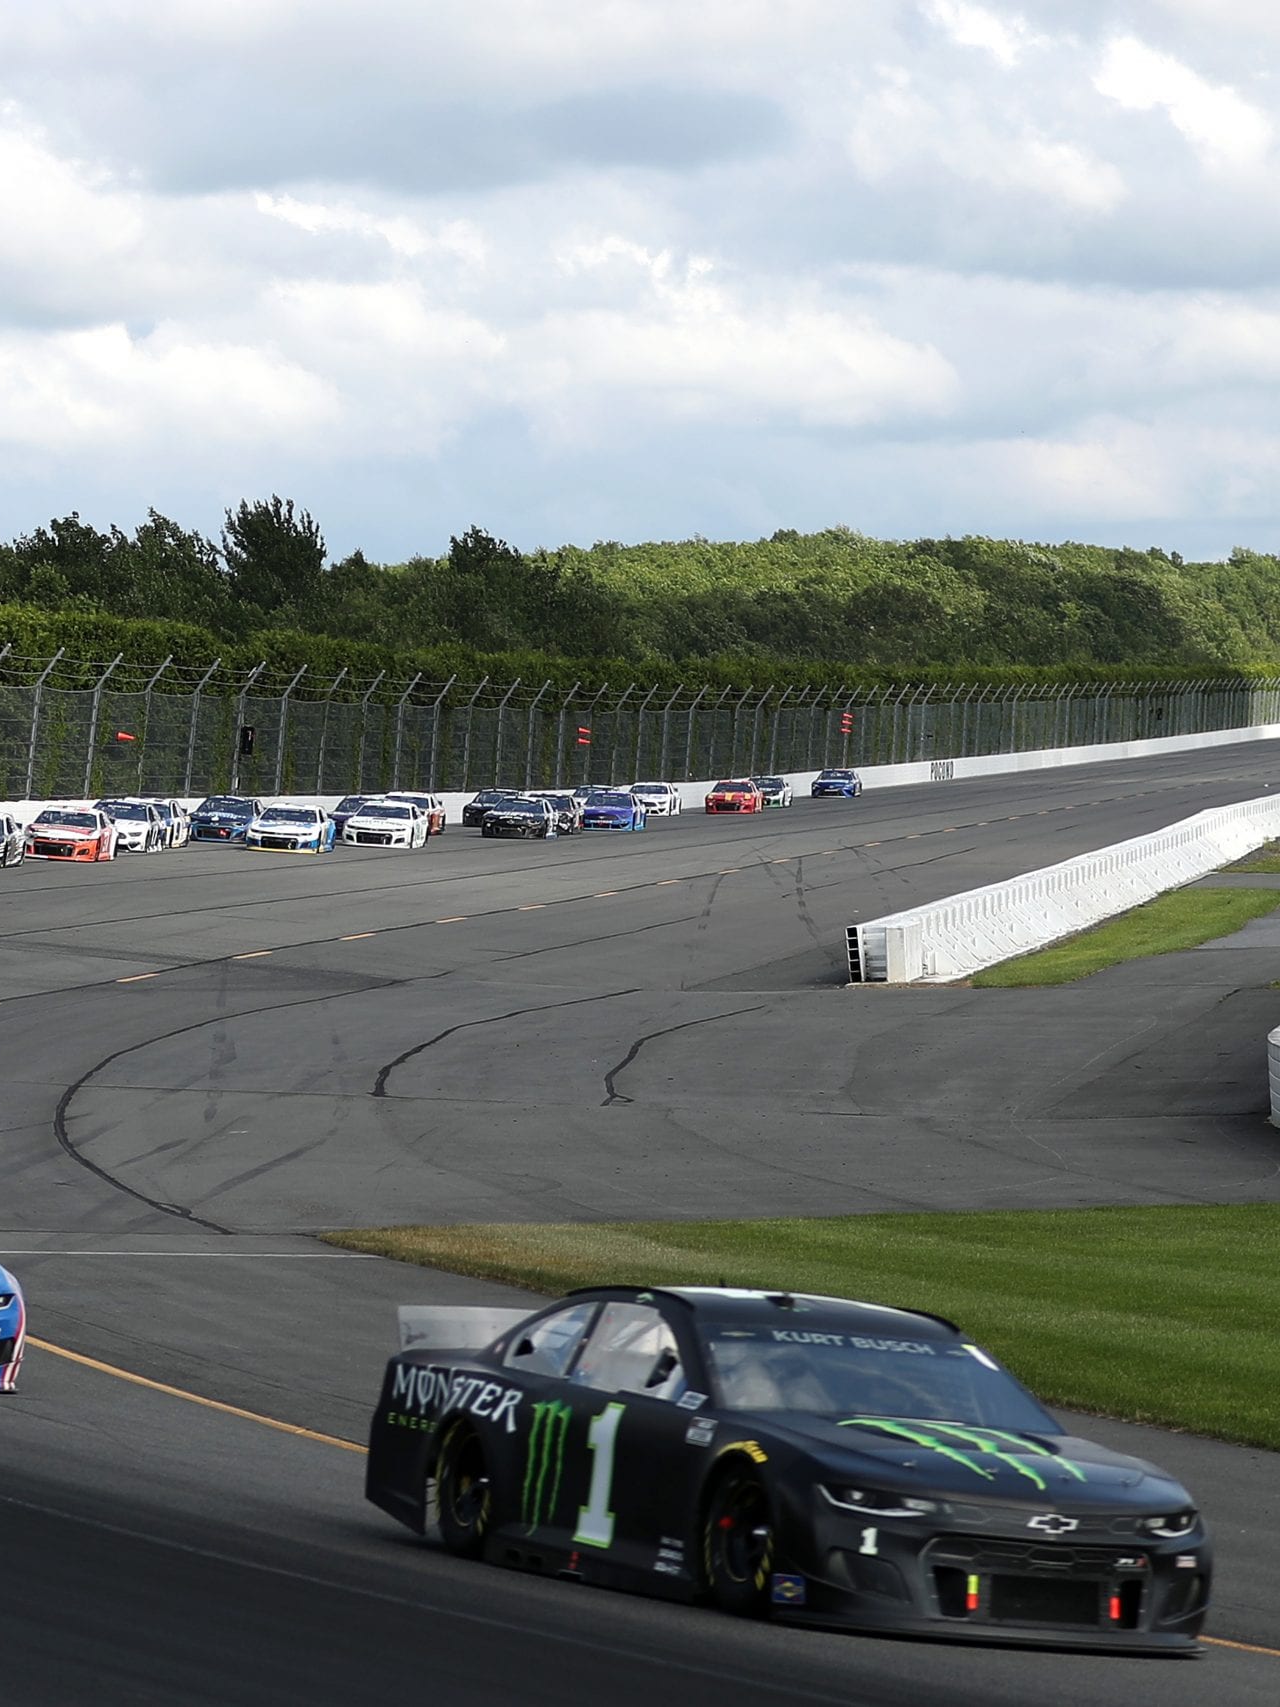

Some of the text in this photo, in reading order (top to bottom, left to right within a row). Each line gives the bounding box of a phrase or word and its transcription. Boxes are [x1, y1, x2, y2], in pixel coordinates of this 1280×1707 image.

[772, 1330, 936, 1355] KURT BUSCH
[392, 1363, 523, 1433] MONSTER
[572, 1402, 626, 1548] 1
[860, 1527, 878, 1555] 1
